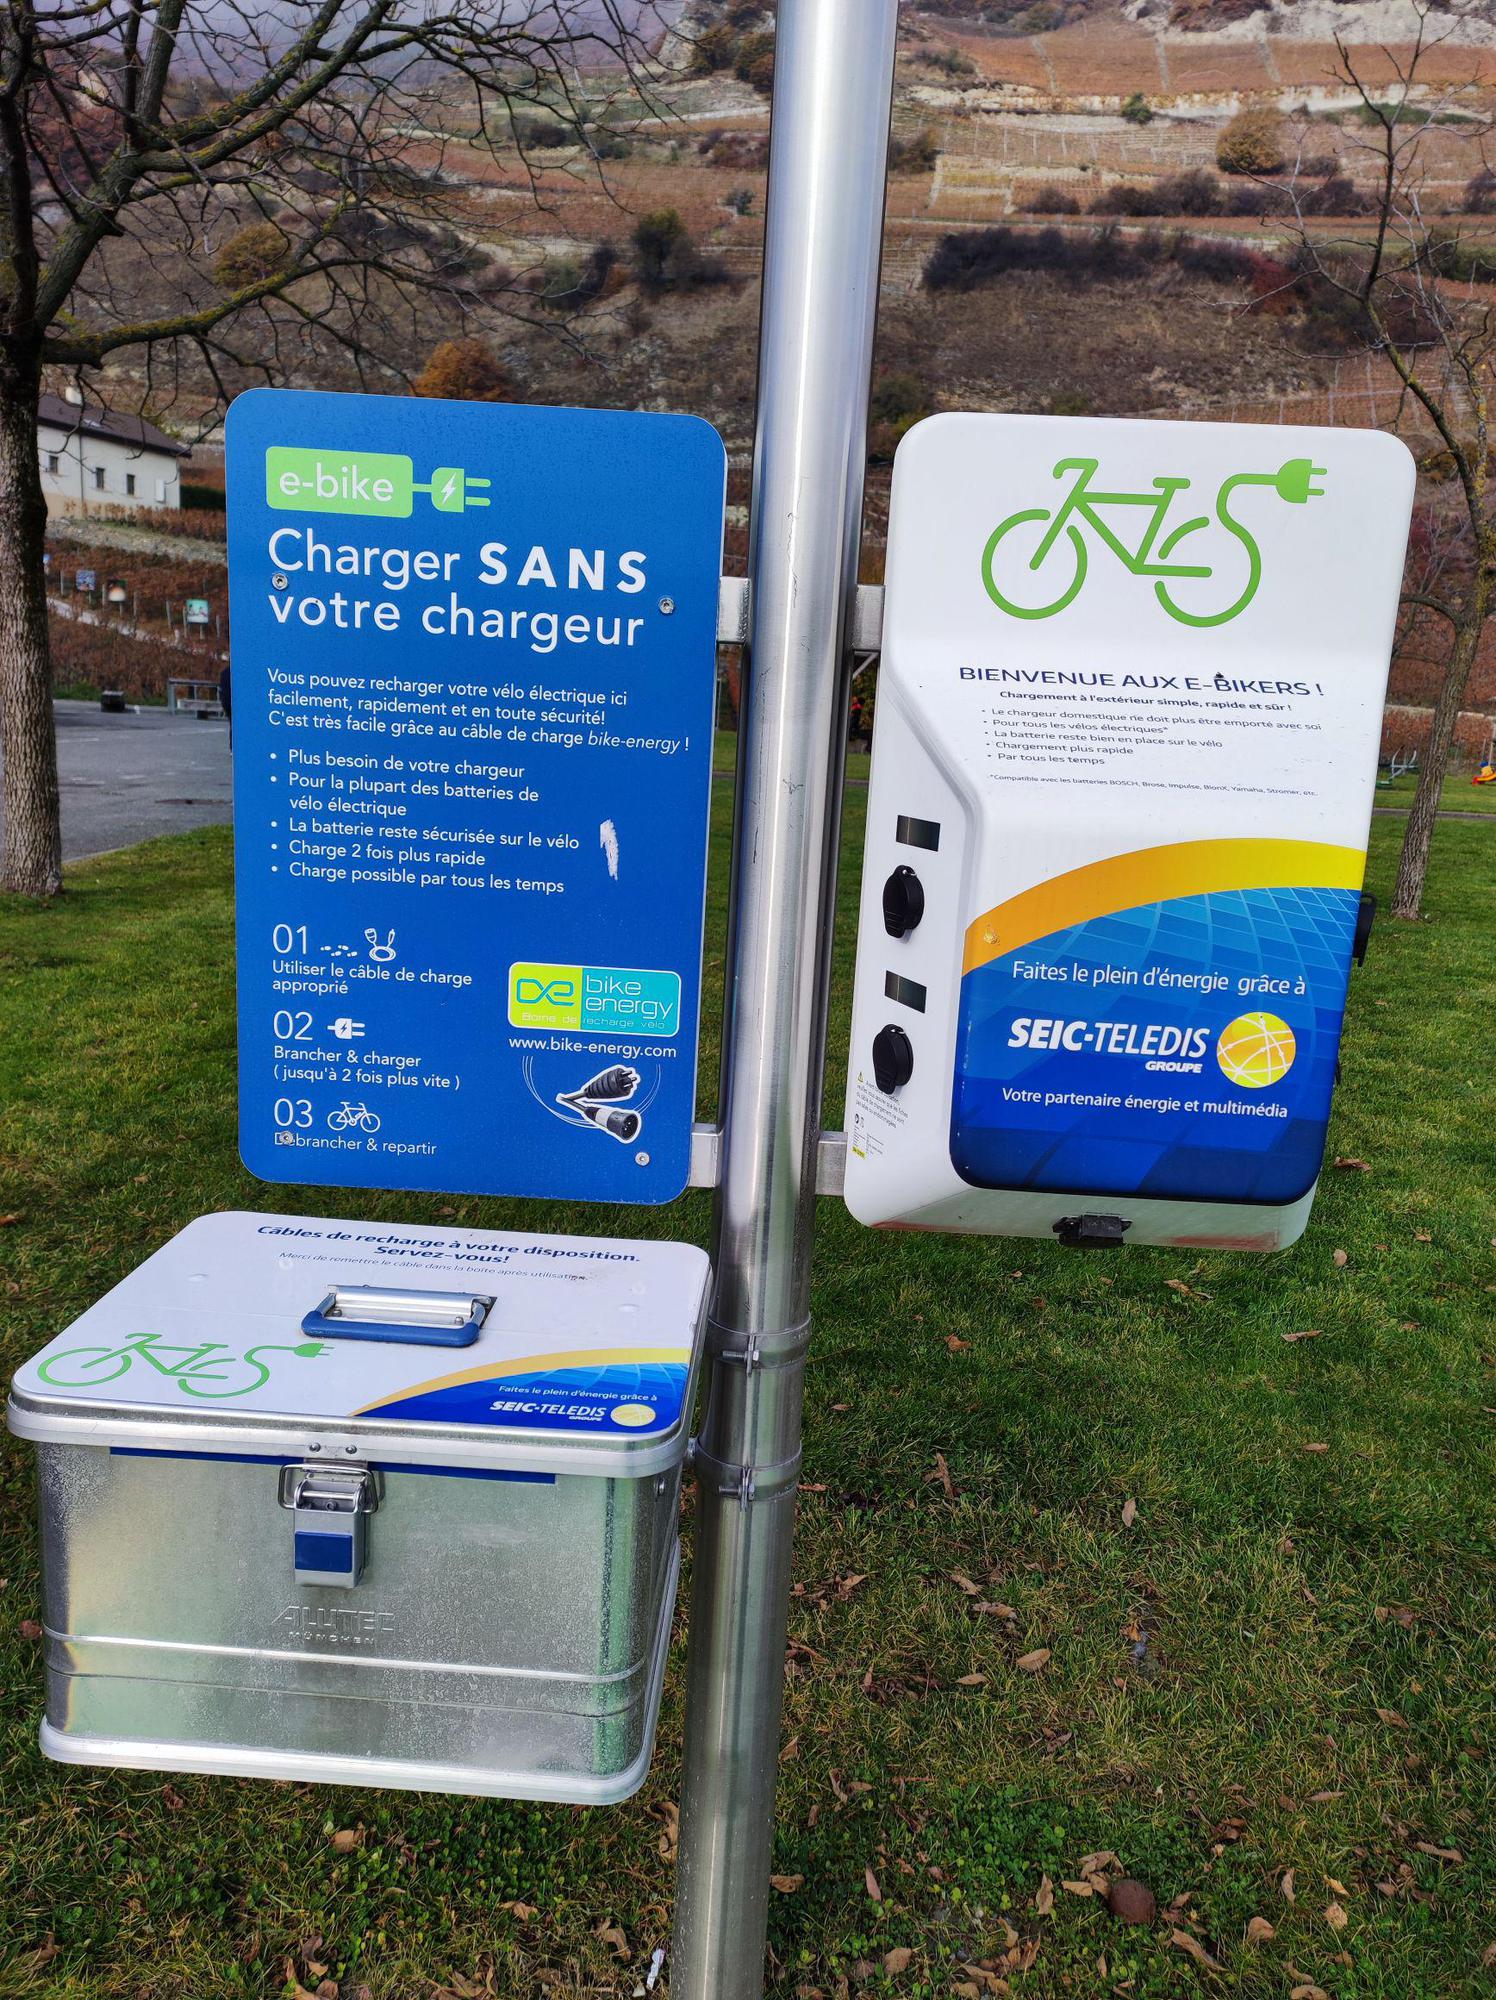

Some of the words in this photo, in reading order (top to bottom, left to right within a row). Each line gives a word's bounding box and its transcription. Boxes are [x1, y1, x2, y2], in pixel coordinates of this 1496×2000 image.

[279, 464, 394, 502] e-bike
[268, 527, 460, 590] Charger
[478, 542, 647, 594] SANS
[268, 592, 400, 631] votre
[422, 592, 644, 653] chargeur
[267, 667, 305, 685] Vous
[309, 675, 365, 689] pouvez
[370, 675, 444, 697] recharger
[447, 683, 488, 697] votre
[492, 683, 524, 699] vélo
[528, 684, 606, 707] électrique
[611, 690, 627, 705] ici
[959, 667, 1115, 686] BIENVENUE
[1121, 674, 1180, 689] AUX
[1184, 677, 1310, 695] E-BIKERS
[267, 688, 352, 711] facilement,
[358, 696, 447, 715] rapidement
[451, 703, 467, 716] et
[471, 706, 490, 718] en
[494, 706, 536, 721] toute
[540, 707, 605, 725] sécurité!
[999, 691, 1077, 701] Chargement
[1089, 694, 1154, 704] l'extérieur
[1156, 698, 1202, 708] simple,
[1205, 701, 1246, 709] rapide
[268, 710, 308, 727] C'est
[312, 713, 341, 729] très
[345, 714, 386, 732] facile
[390, 719, 434, 737] grâce
[438, 725, 456, 737] au
[461, 723, 502, 740] câble
[507, 725, 527, 741] de
[531, 727, 583, 748] charge
[588, 730, 680, 754] bike-energy
[1006, 709, 1057, 718] chargeur
[1059, 711, 1126, 721] domestique
[1146, 714, 1169, 722] doit
[1171, 716, 1196, 724] plus
[1198, 717, 1221, 725] être
[1223, 720, 1273, 728] emporté
[1050, 721, 1066, 729] les
[1068, 722, 1098, 730] vélos
[995, 741, 1068, 751] Chargement
[1069, 744, 1094, 753] plus
[1096, 746, 1133, 754] rapide
[1009, 730, 1055, 740] batterie
[1089, 734, 1115, 742] bien
[1134, 736, 1165, 744] place
[1198, 739, 1222, 747] vélo
[288, 748, 321, 765] Plus
[325, 750, 378, 768] besoin
[383, 754, 404, 770] de
[408, 759, 450, 773] votre
[454, 759, 525, 781] chargeur
[997, 752, 1017, 760] Par
[1048, 754, 1065, 762] les
[1067, 756, 1105, 765] temps
[289, 771, 326, 788] Pour
[331, 773, 344, 789] la
[349, 775, 406, 795] plupart
[410, 779, 439, 796] des
[444, 781, 514, 800] batteries
[518, 786, 539, 802] de
[289, 794, 323, 810] vélo
[327, 796, 407, 819] électrique
[289, 817, 306, 832] La
[312, 817, 374, 836] batterie
[379, 826, 418, 839] reste
[422, 826, 495, 844] sécurisée
[499, 834, 524, 845] sur
[528, 831, 542, 847] le
[546, 833, 579, 849] vélo
[289, 839, 347, 860] Charge
[351, 843, 361, 858] 2
[365, 843, 394, 860] fois
[398, 846, 430, 864] plus
[435, 850, 485, 867] rapide
[289, 861, 346, 882] Charge
[351, 867, 416, 883] possible
[420, 874, 447, 888] par
[450, 874, 485, 888] tous
[490, 873, 511, 889] les
[514, 878, 564, 895] temps
[272, 923, 306, 954] 01
[272, 959, 326, 976] Utiliser
[330, 962, 346, 983] le
[349, 964, 390, 980] câble
[395, 966, 415, 981] de
[419, 968, 472, 988] charge
[585, 975, 641, 996] bike
[1013, 960, 1068, 981] Faites
[1072, 962, 1088, 982] le
[1092, 964, 1138, 987] plein
[1142, 967, 1229, 994] d'énergie
[1237, 974, 1290, 996] grâce
[1293, 976, 1305, 995] à
[272, 980, 348, 996] approprié
[585, 996, 674, 1020] energy
[273, 1010, 313, 1040] 02
[1007, 1017, 1210, 1058] SEIC-TELEDIS
[274, 1045, 342, 1062] Brancher
[363, 1050, 421, 1070] charger
[508, 1036, 676, 1059] www.bike-energy.com
[282, 1064, 337, 1083] jusqu'à
[341, 1068, 351, 1082] 2
[355, 1068, 382, 1084] fois
[387, 1071, 418, 1088] plus
[422, 1073, 450, 1088] vite
[1145, 1060, 1203, 1073] GROUPE
[274, 1097, 313, 1128] 03
[1002, 1087, 1042, 1102] Votre
[1044, 1092, 1121, 1107] partenaire
[1124, 1094, 1181, 1113] énergie
[1183, 1100, 1200, 1112] et
[1202, 1100, 1288, 1118] multimédia
[382, 1141, 437, 1156] repartir
[257, 1226, 323, 1238] Câbles
[326, 1231, 352, 1240] de
[355, 1235, 445, 1248] recharge
[448, 1240, 461, 1248] à
[466, 1243, 519, 1252] votre
[523, 1246, 639, 1262] disposition.
[279, 1252, 311, 1260] Merci
[374, 1246, 510, 1263] Servez-vous!
[498, 1385, 529, 1393] Faites
[542, 1388, 568, 1396] plein
[570, 1390, 618, 1399] d'énergie
[489, 1401, 607, 1417] SEIC-TELEDIS
